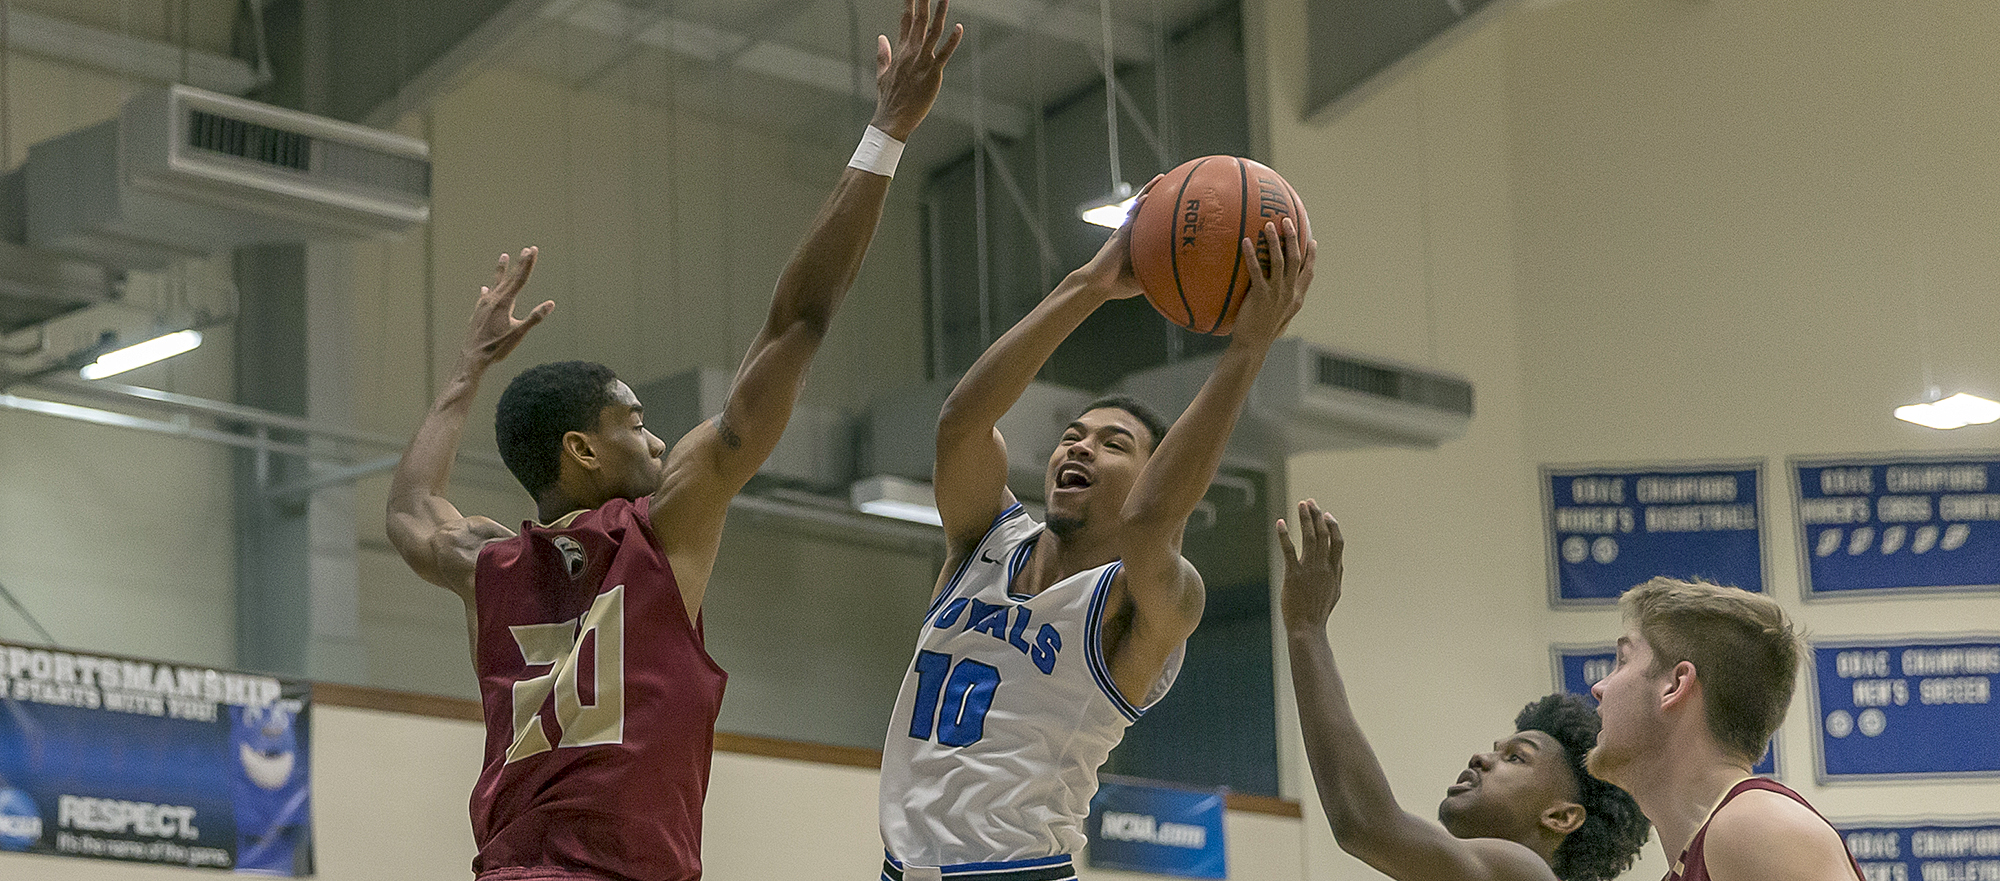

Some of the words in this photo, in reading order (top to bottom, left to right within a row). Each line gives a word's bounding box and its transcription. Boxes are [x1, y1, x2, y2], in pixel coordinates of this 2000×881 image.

[1182, 199, 1200, 247] ROCK
[1938, 493, 2000, 521] COUNT
[933, 597, 1063, 676] OYALS
[908, 648, 1002, 748] 10
